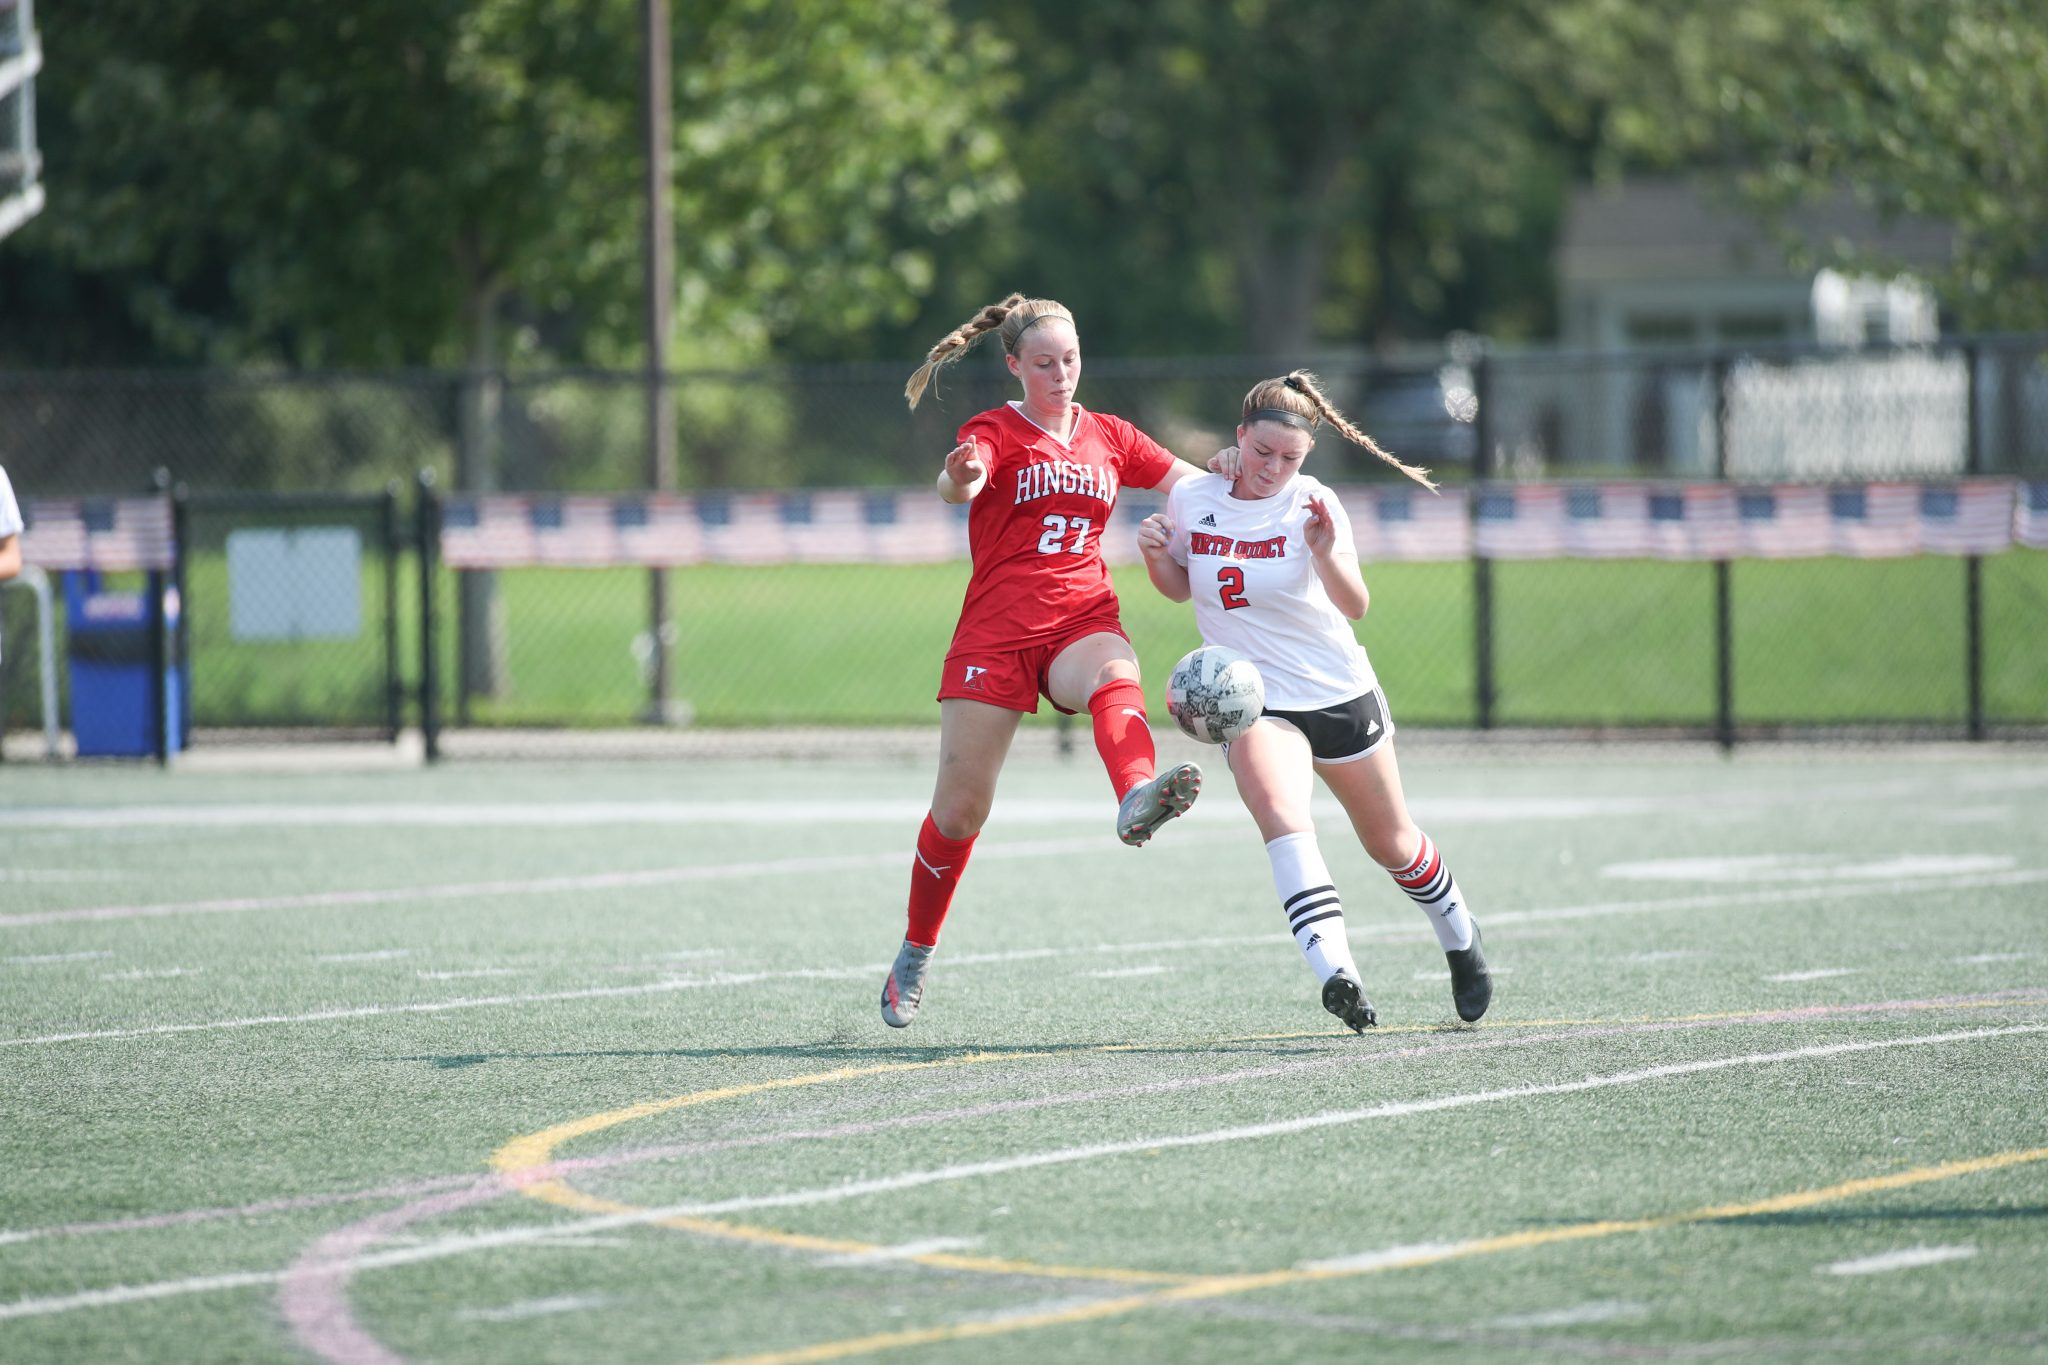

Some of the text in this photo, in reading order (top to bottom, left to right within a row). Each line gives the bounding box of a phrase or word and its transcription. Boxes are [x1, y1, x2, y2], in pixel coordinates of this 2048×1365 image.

[1037, 513, 1092, 555] 27
[1234, 535, 1287, 560] QUINCY
[1217, 566, 1251, 611] 2
